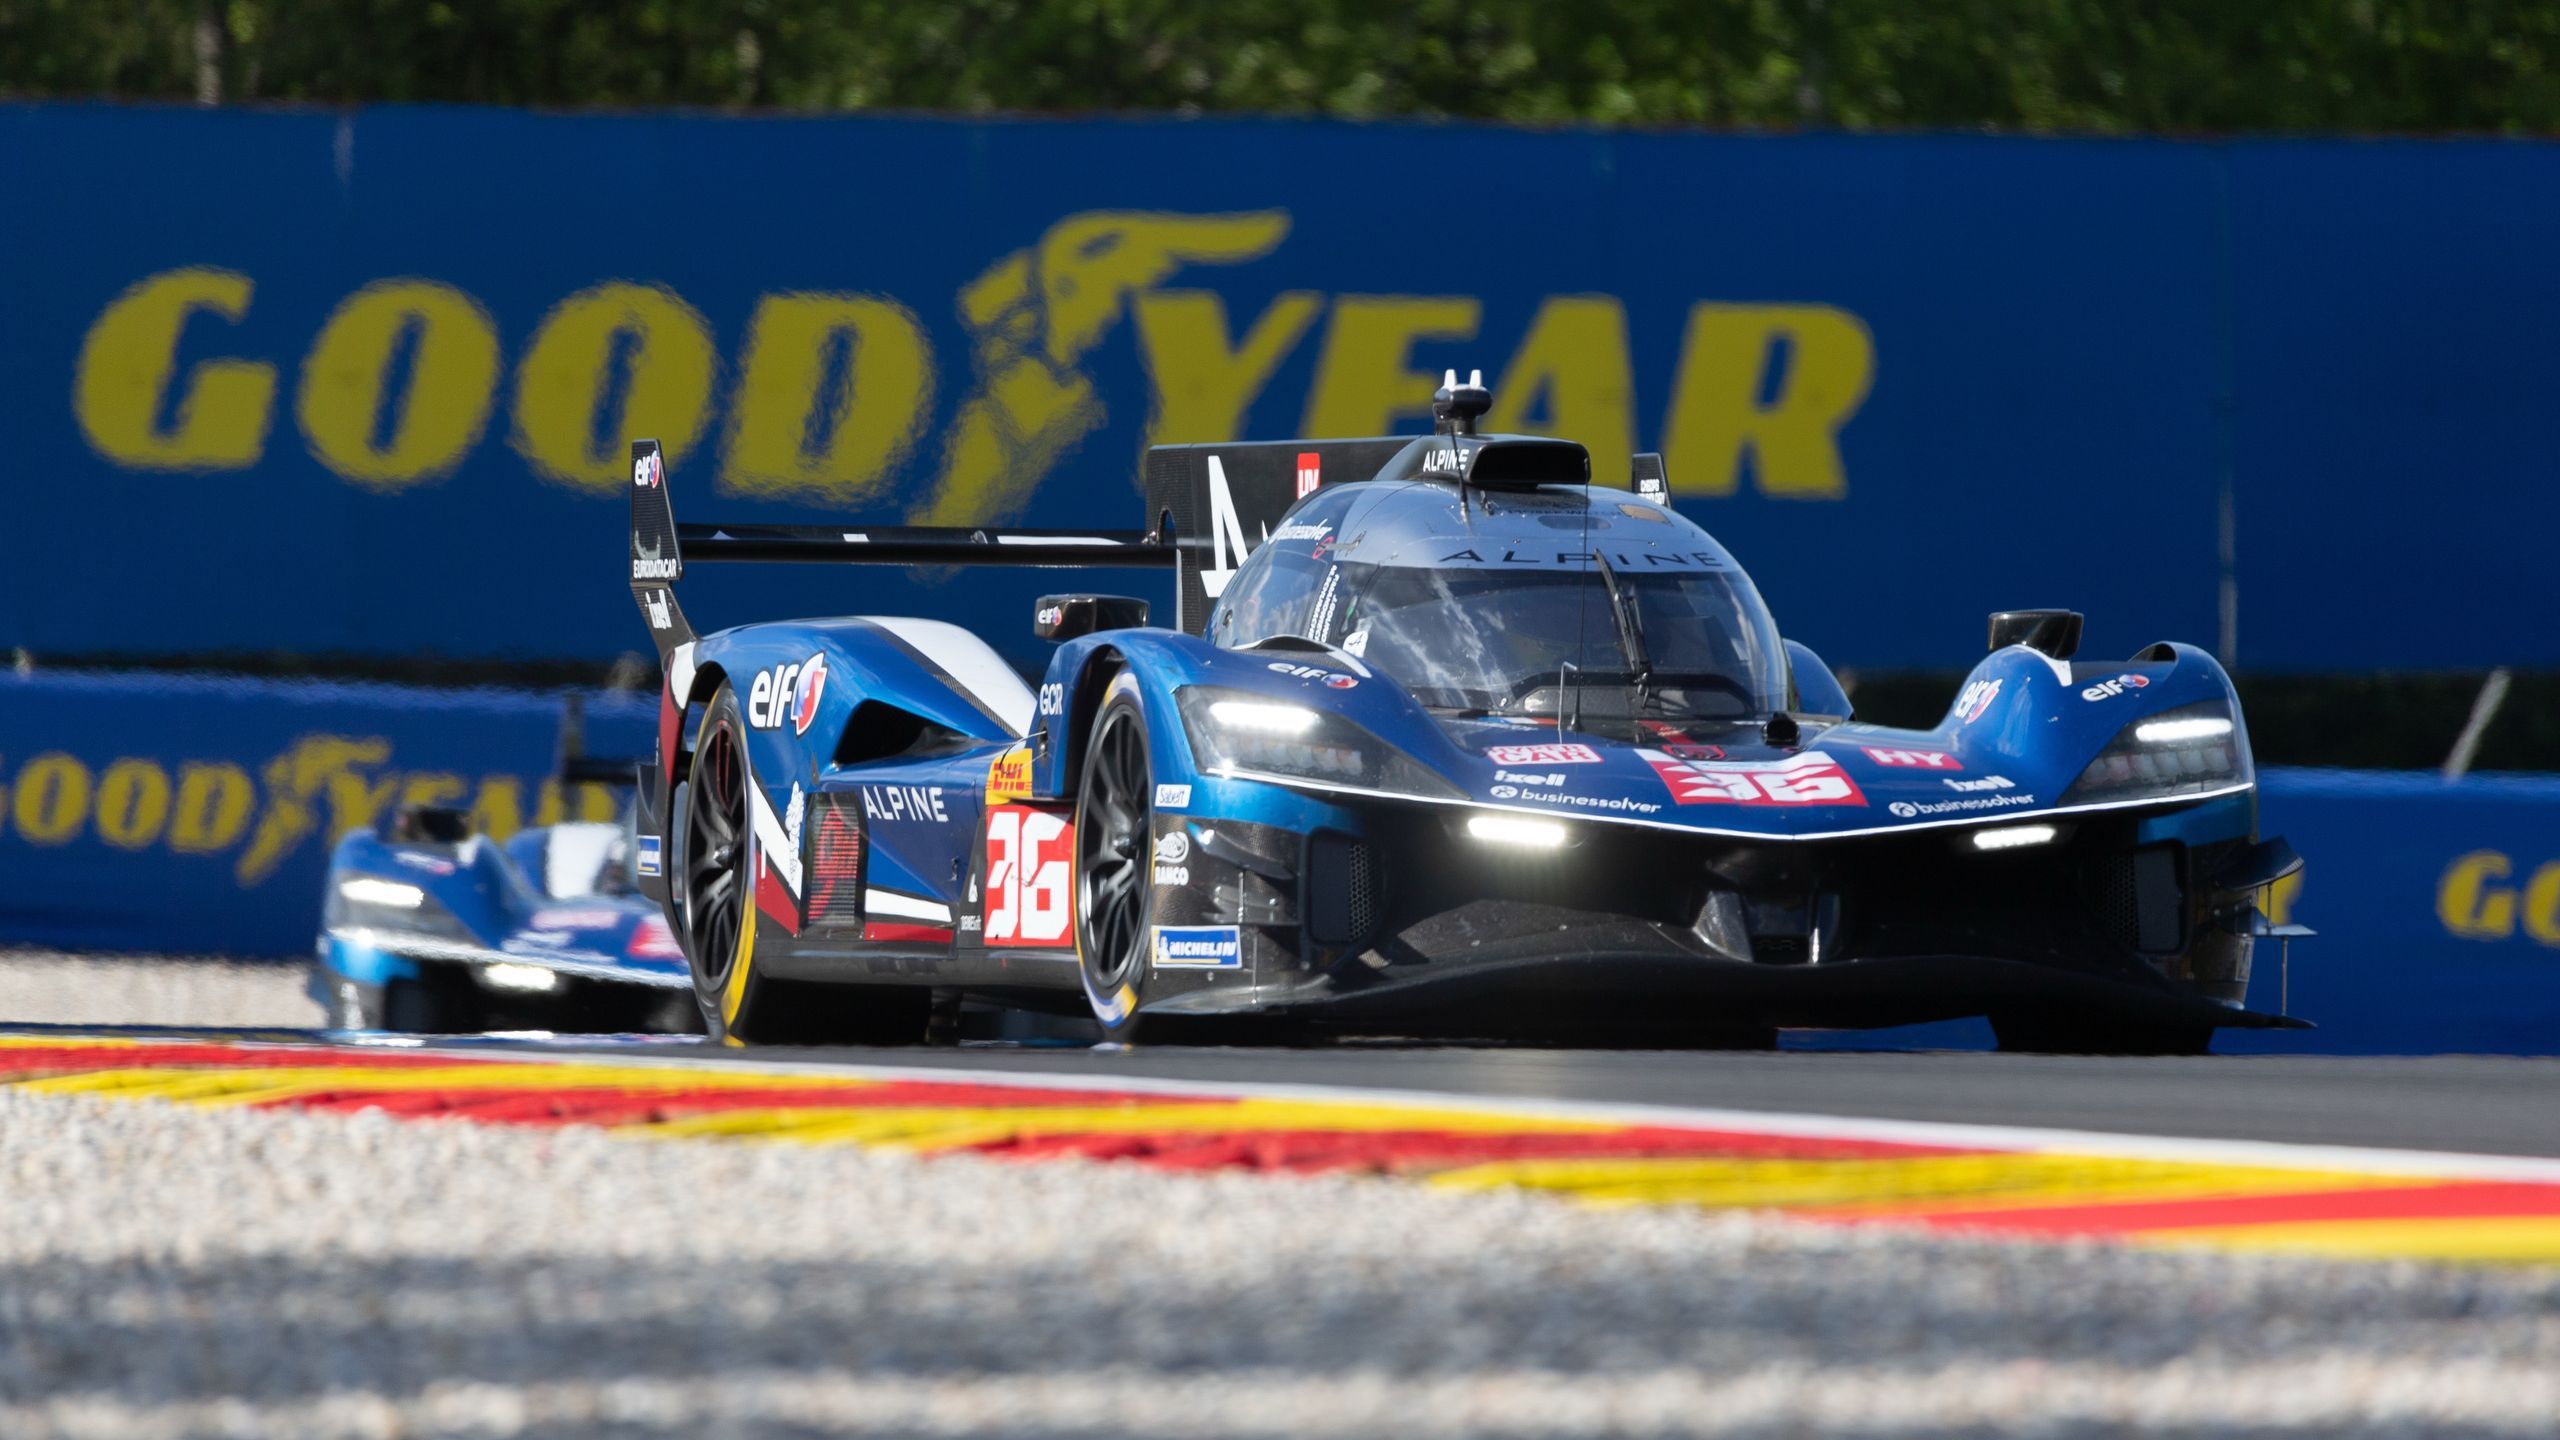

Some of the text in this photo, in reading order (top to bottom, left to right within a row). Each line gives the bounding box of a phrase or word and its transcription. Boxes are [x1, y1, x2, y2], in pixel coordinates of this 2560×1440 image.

[635, 455, 652, 487] elf
[1423, 448, 1470, 472] ALPINE
[633, 559, 677, 579] EURODATACAR
[1438, 548, 1724, 567] ALPINE
[1038, 607, 1056, 625] elf
[1267, 662, 1330, 681] elf
[748, 663, 801, 729] elf
[1039, 683, 1064, 717] GCR
[1954, 679, 1991, 719] elf
[2081, 678, 2124, 702] elf
[1497, 751, 1592, 763] CAR
[1870, 749, 1949, 767] HY
[1664, 763, 1854, 802] 36
[862, 785, 949, 823] ALPINE
[1520, 787, 1663, 814] businessolver
[1916, 792, 2035, 816] businessolver
[984, 811, 1073, 940] 36
[1169, 941, 1237, 956] MICHELIN
